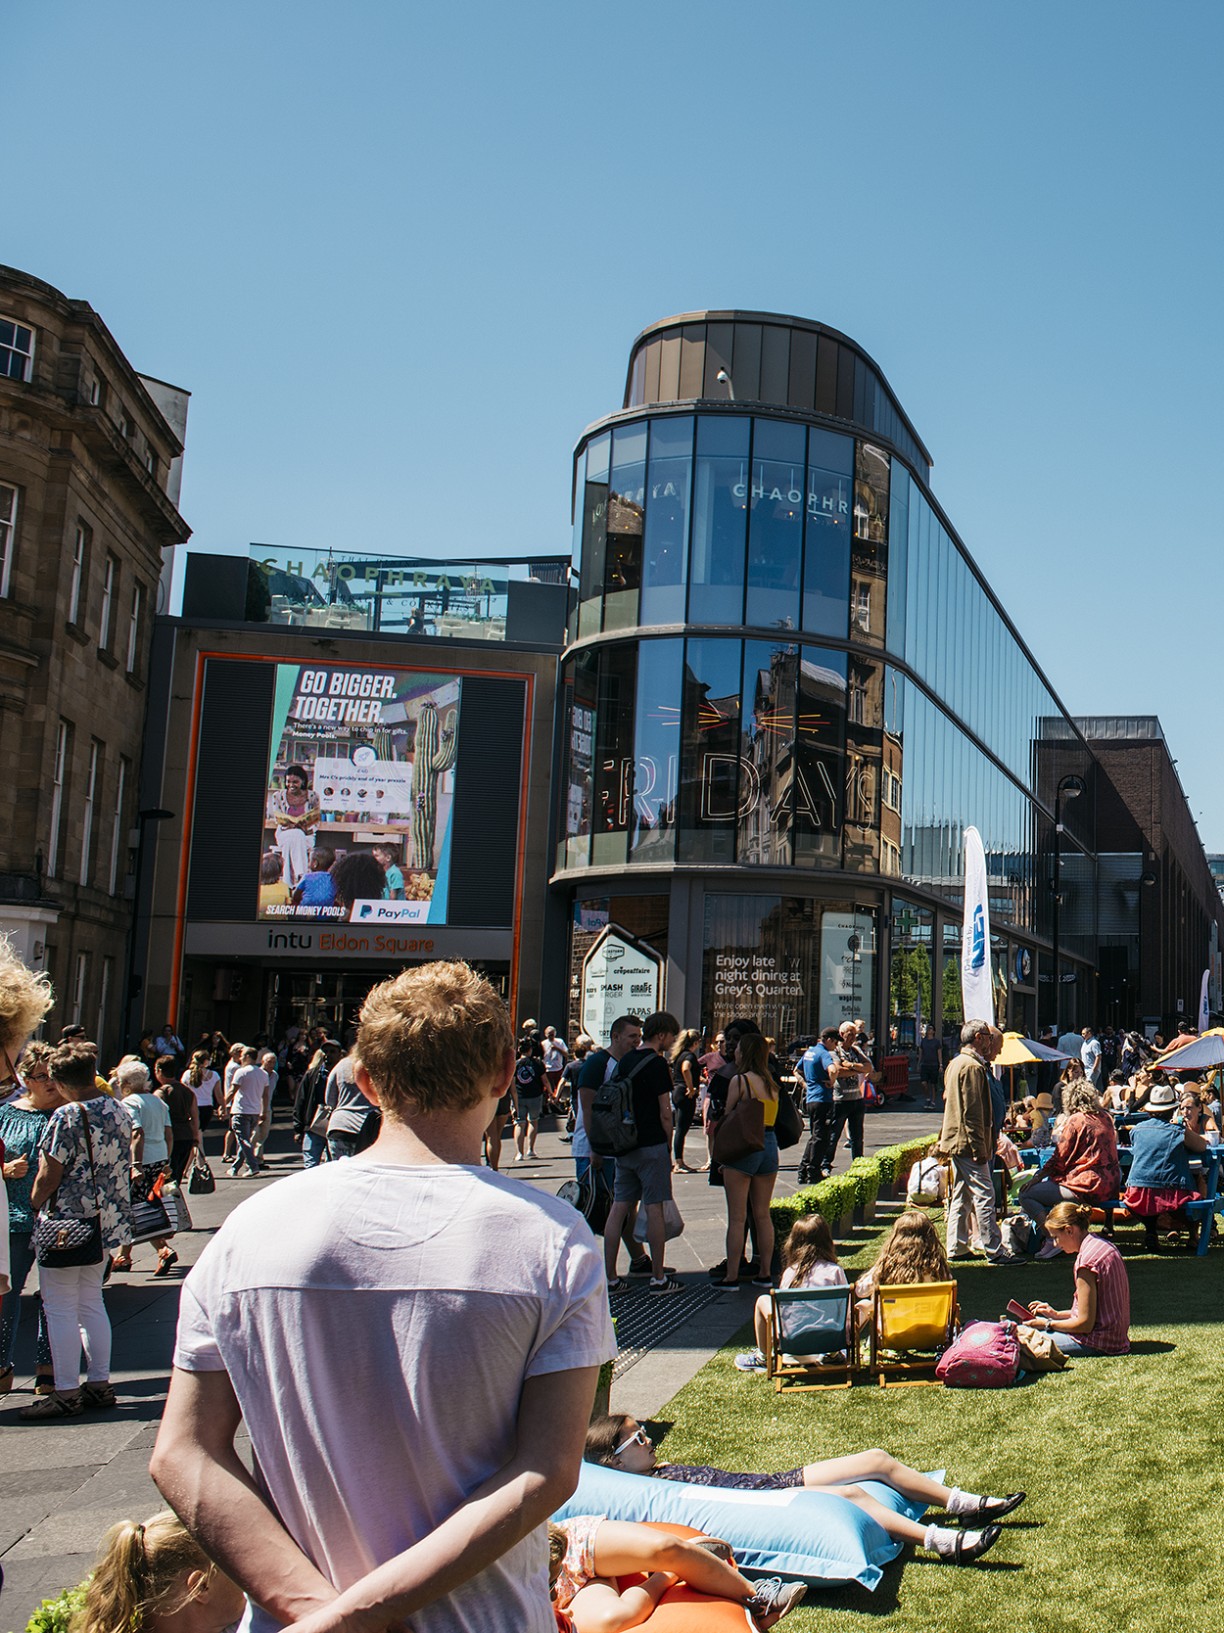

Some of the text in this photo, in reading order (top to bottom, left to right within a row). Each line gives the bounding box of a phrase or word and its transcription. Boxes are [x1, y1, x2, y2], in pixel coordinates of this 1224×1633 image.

[259, 558, 497, 594] CHAOPHRAYA
[300, 670, 398, 699] GO BIGGER.
[294, 696, 385, 723] TOGETHER.
[293, 721, 317, 730] There's
[292, 730, 315, 739] Money
[265, 904, 346, 917] SEARCH MONEY POOLS
[377, 908, 421, 920] PayPal
[268, 929, 434, 955] intu Eldon Square
[716, 954, 776, 969] Enjoy late
[715, 969, 801, 983] night dining at
[715, 983, 801, 998] Grey's Quarter
[734, 1002, 753, 1011] open
[713, 1010, 726, 1018] the
